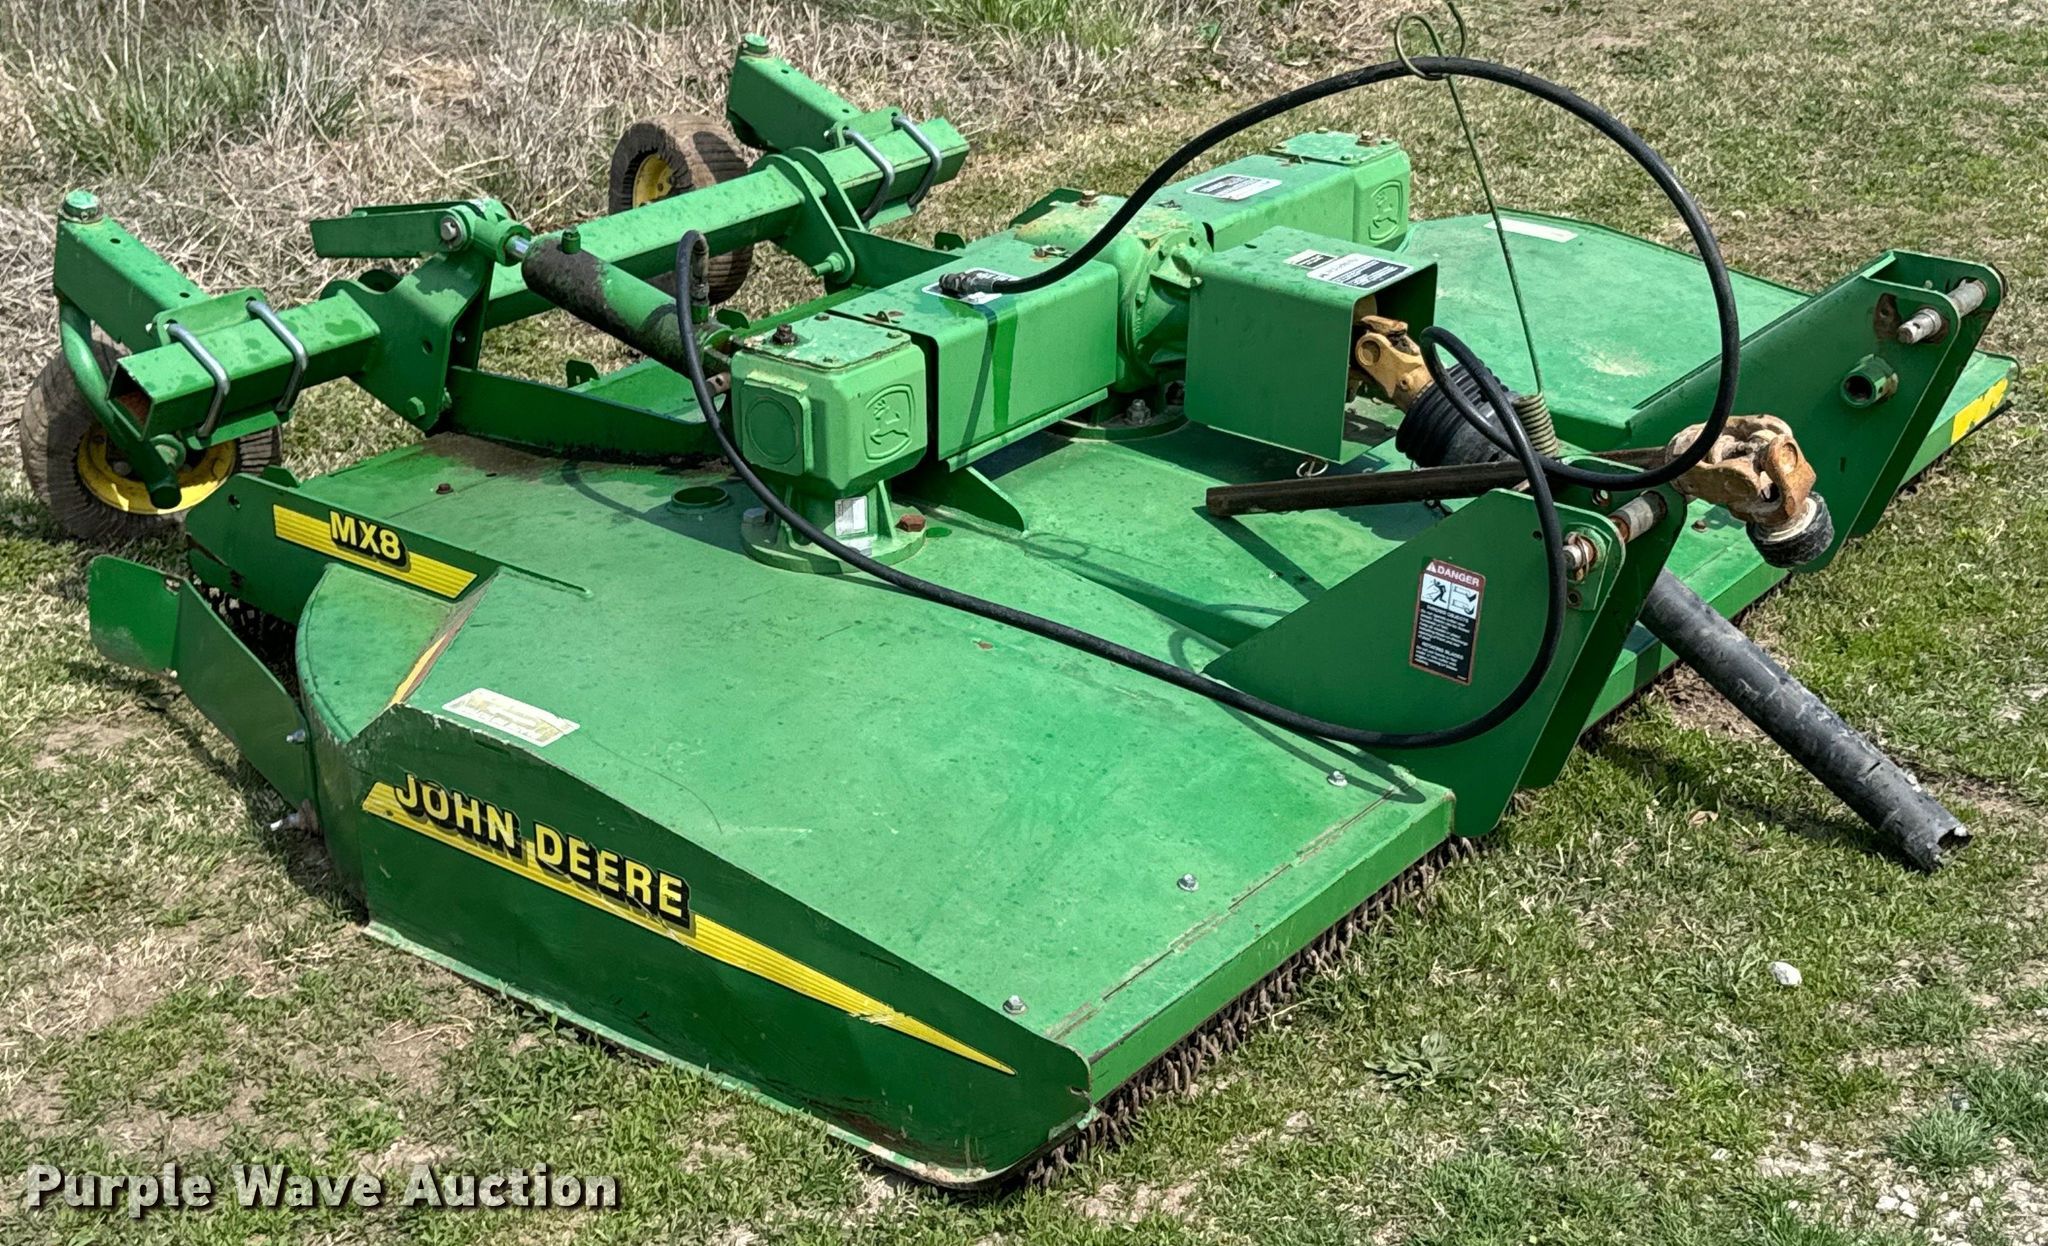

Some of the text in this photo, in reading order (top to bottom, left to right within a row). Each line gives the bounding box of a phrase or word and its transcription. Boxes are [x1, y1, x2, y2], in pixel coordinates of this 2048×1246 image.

[330, 510, 402, 561] MX8
[1437, 565, 1480, 587] DANGER
[395, 773, 684, 918] JOHN DEERE
